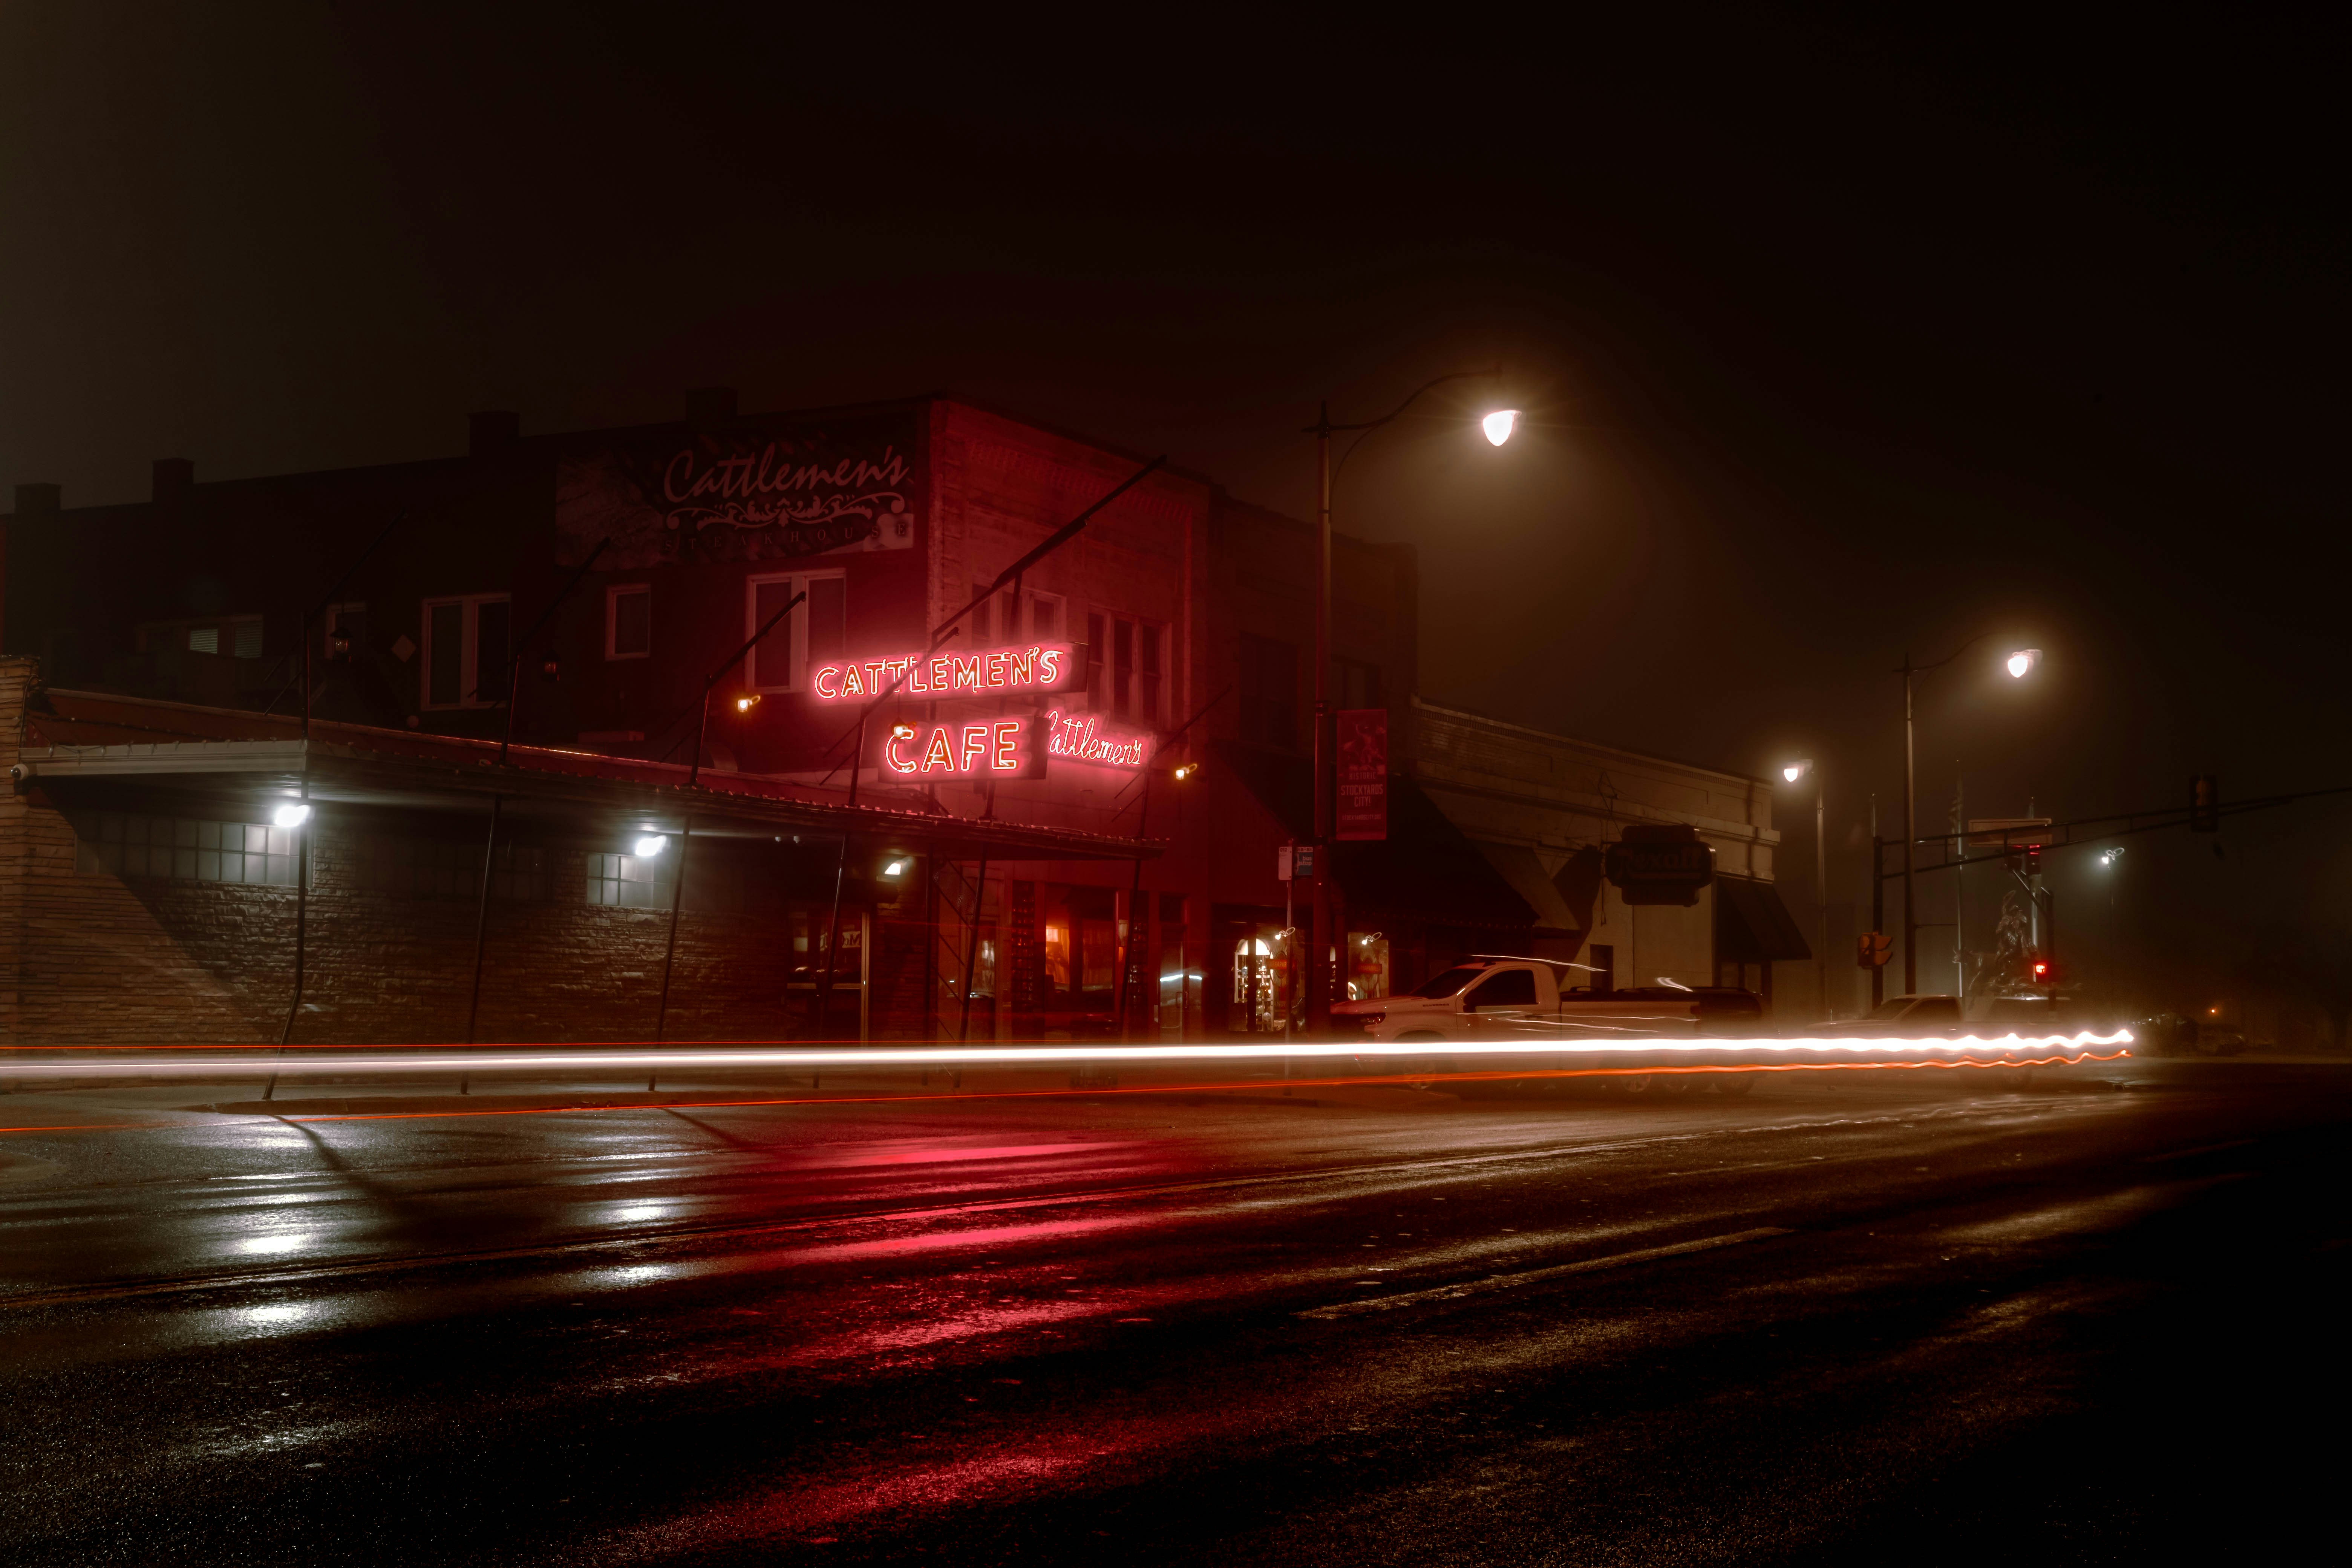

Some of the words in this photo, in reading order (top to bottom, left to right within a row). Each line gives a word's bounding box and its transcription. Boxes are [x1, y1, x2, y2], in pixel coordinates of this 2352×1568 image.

[664, 442, 910, 503] Cattlemen's
[663, 523, 906, 551] STEAKHOUSE
[814, 646, 1063, 699] CATTLEMEN'S
[885, 721, 1021, 774] CAFE
[1340, 784, 1383, 796] STOCKYARDS
[1349, 772, 1376, 781] HISTORIC
[1354, 796, 1372, 807] CITY!
